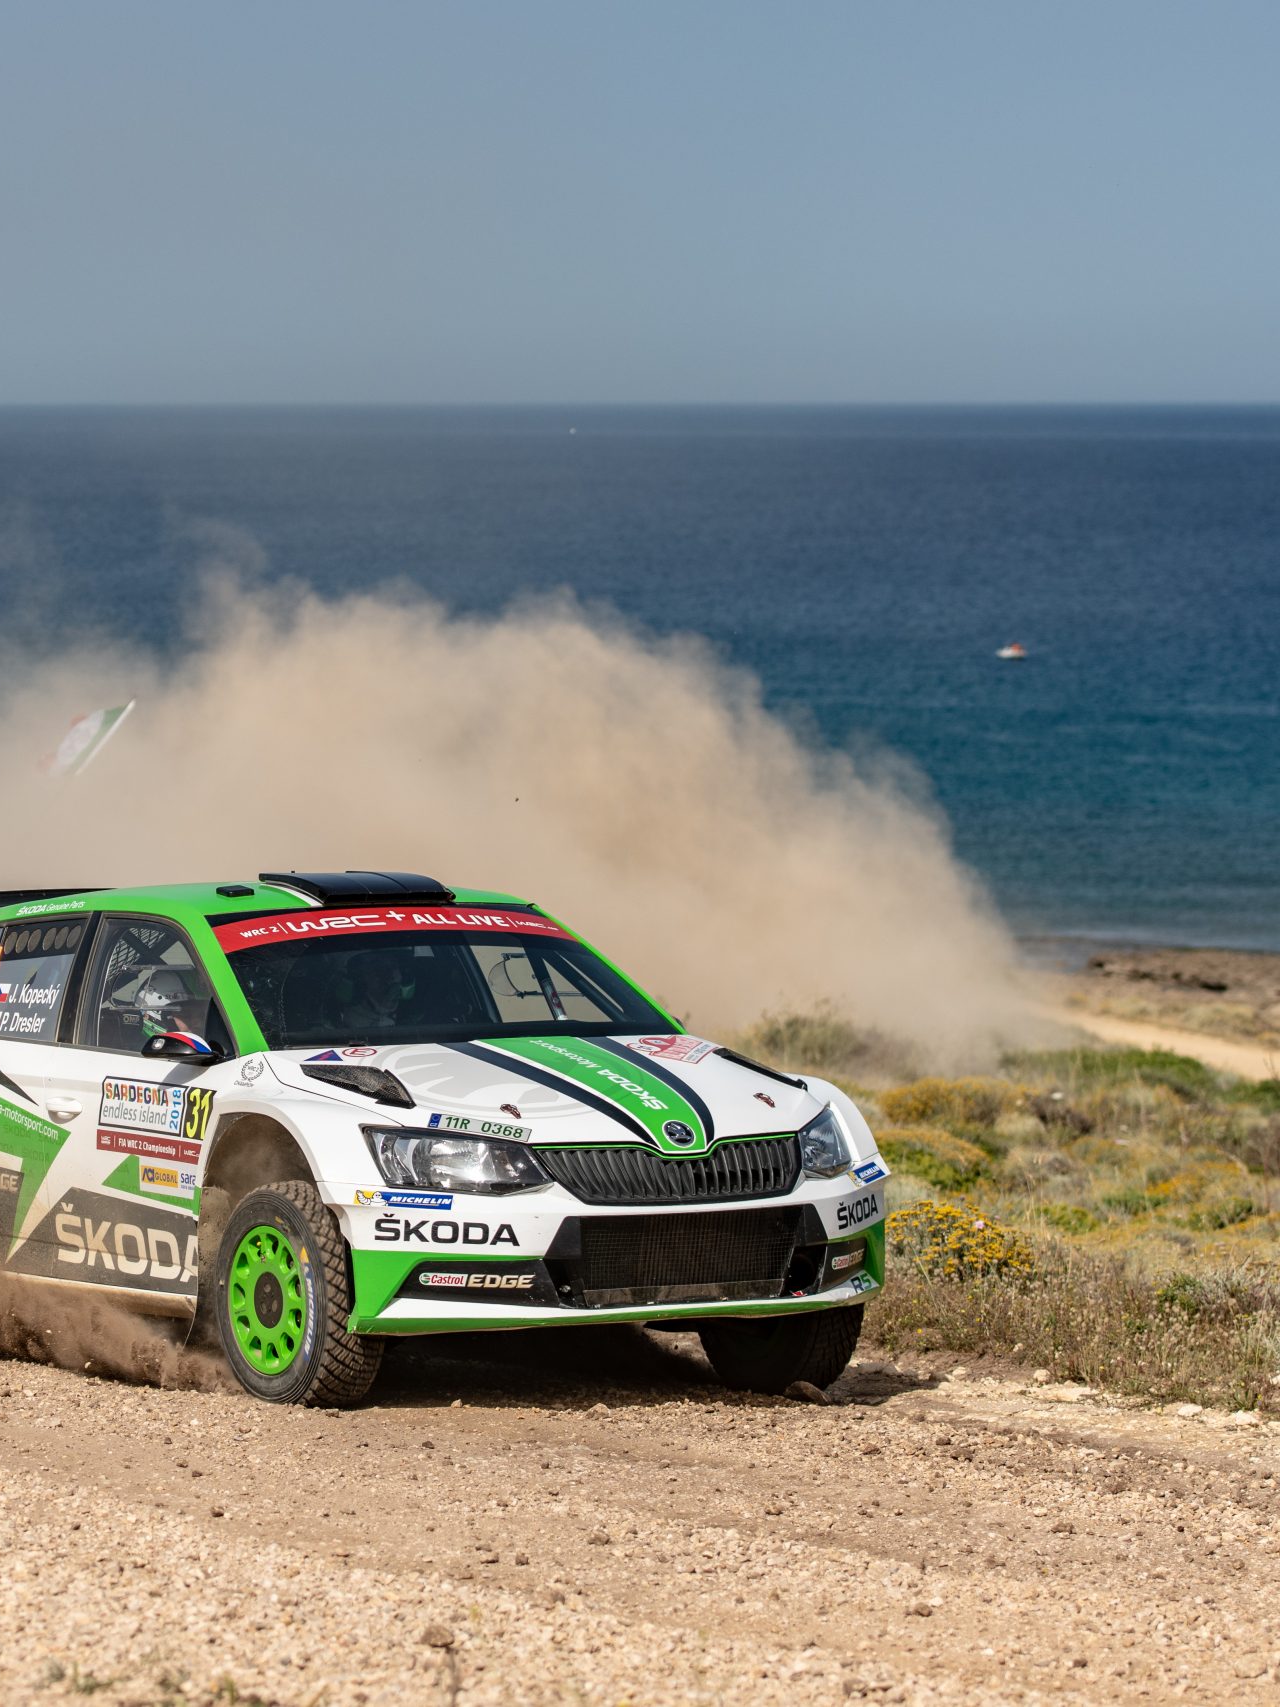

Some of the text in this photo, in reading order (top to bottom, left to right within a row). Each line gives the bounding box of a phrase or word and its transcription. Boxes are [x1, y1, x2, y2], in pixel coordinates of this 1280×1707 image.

[46, 902, 69, 912] Genuine
[69, 901, 86, 910] Parts
[240, 928, 268, 938] WRC
[412, 914, 457, 925] ALL
[456, 914, 510, 928] LIVE
[8, 983, 60, 1010] J. Kopecký
[0, 1011, 46, 1032] P. Dresler
[530, 1039, 602, 1069] Motorsport
[105, 1082, 169, 1107] SARDEGNA
[597, 1069, 668, 1110] ŠKODA
[102, 1102, 168, 1126] endless island
[169, 1089, 182, 1130] 2018
[186, 1088, 212, 1140] 31
[445, 1116, 524, 1138] 11R 0368
[118, 1138, 127, 1148] FIA
[127, 1139, 138, 1150] WRC
[138, 1141, 142, 1150] 2
[142, 1142, 176, 1156] Championship
[154, 1172, 178, 1184] GLOBAL
[389, 1196, 452, 1205] MICHELIN
[837, 1194, 879, 1230] ŠKODA
[374, 1213, 520, 1247] ŠKODA
[431, 1274, 536, 1289] Castrol EDGE
